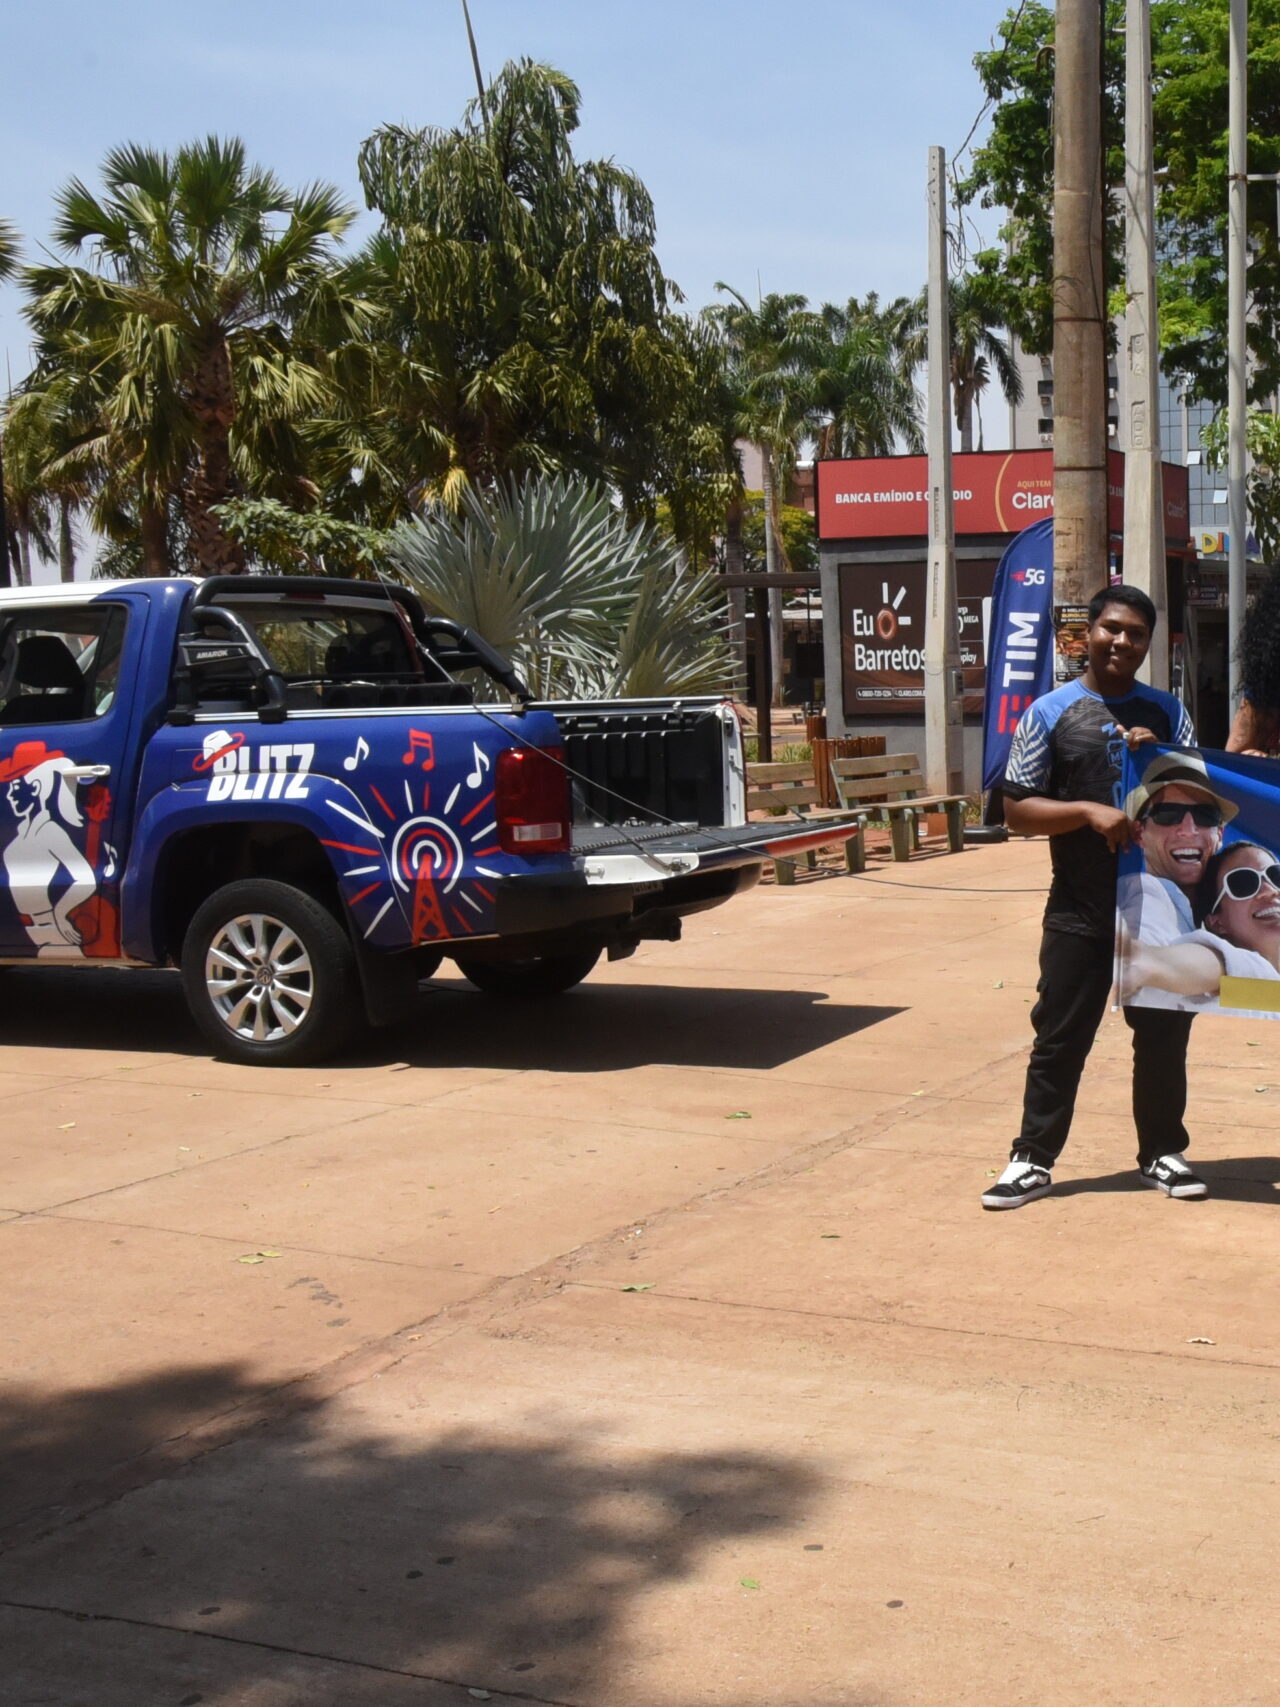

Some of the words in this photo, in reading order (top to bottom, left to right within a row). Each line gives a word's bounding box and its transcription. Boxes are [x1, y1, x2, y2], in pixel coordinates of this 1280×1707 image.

[1017, 480, 1035, 489] AQUI
[835, 493, 872, 504] BANCA
[874, 489, 914, 503] EMÍDIO
[916, 491, 923, 501] E
[1023, 568, 1045, 586] 5G
[853, 609, 875, 636] Eu
[196, 650, 228, 659] AMAROK
[1002, 612, 1040, 688] TIM
[206, 743, 315, 802] BLITZ
